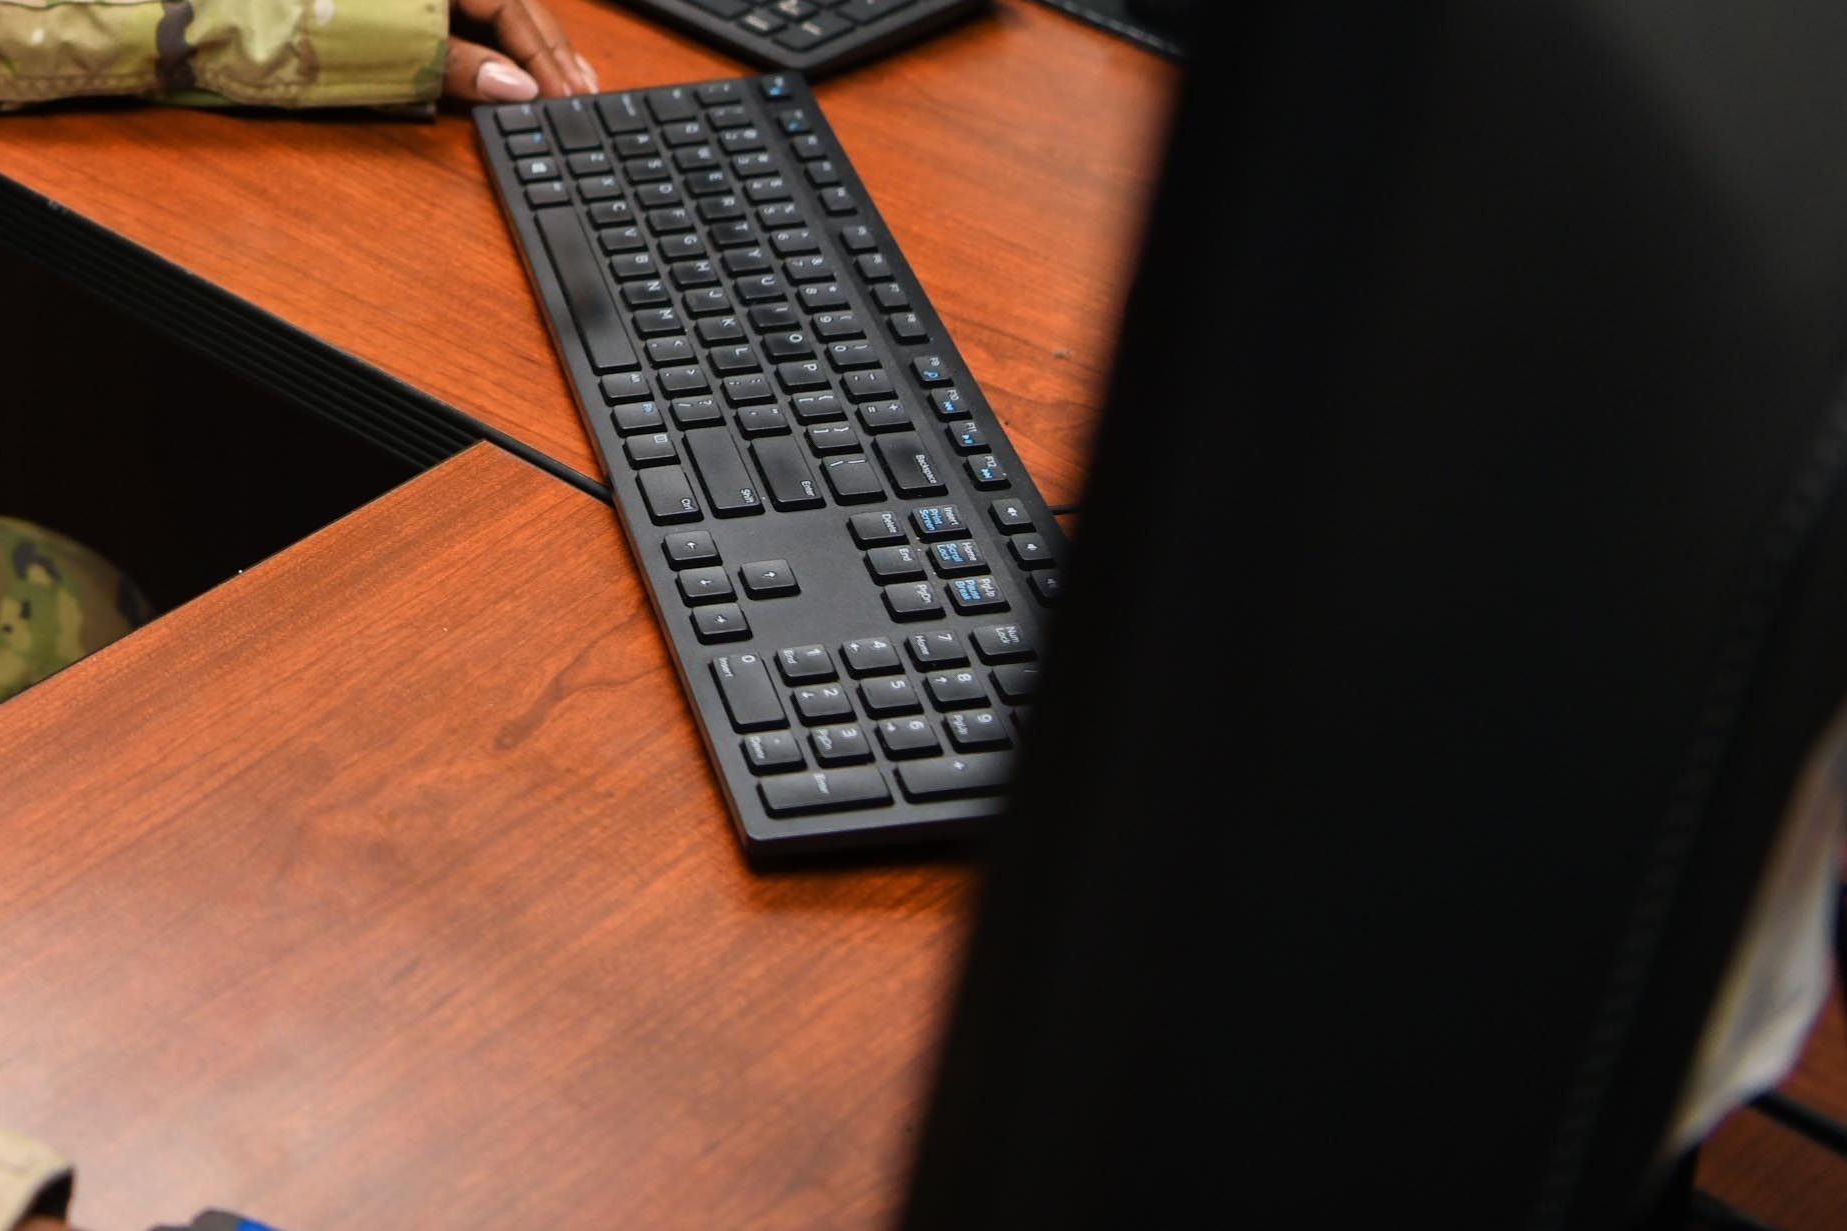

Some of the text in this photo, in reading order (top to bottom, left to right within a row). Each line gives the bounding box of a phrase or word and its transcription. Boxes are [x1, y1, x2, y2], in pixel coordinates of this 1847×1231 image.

[708, 172, 724, 181] E
[612, 201, 627, 211] C
[722, 196, 736, 206] R
[672, 208, 686, 217] F
[624, 227, 637, 237] V
[735, 222, 749, 231] T
[683, 235, 698, 245] G
[777, 231, 790, 241] 6
[748, 248, 762, 258] Y
[634, 254, 649, 264] B
[695, 260, 711, 272] H
[646, 280, 661, 291] N
[760, 275, 775, 286] U
[708, 290, 723, 298] J
[805, 287, 818, 295] 8
[658, 308, 674, 320] M
[819, 315, 832, 323] 9
[721, 317, 736, 327] K
[789, 333, 803, 343] O
[735, 346, 748, 356] L
[834, 345, 847, 353] 0
[929, 356, 941, 367] F9
[803, 363, 818, 372] P
[946, 390, 960, 403] F10
[965, 421, 978, 433] F11
[984, 455, 998, 468] F12
[915, 454, 938, 484] Backspace
[801, 480, 815, 497] Enter
[740, 488, 756, 506] Shift
[680, 498, 694, 512] Ctrl
[919, 508, 935, 531] Screen
[928, 509, 943, 526] Print
[943, 506, 959, 526] Insert
[880, 513, 897, 533] Delete
[898, 547, 913, 562] End
[937, 544, 952, 561] Lock
[945, 543, 964, 562] Scroll
[961, 542, 977, 561] Home
[955, 580, 971, 600] Break
[966, 579, 981, 600] Pause
[981, 578, 996, 597] PgUp
[914, 583, 932, 604] PgDn
[937, 633, 953, 641] 7
[994, 627, 1011, 644] Lock
[1005, 626, 1019, 644] Num
[873, 640, 887, 649] 4
[913, 635, 930, 655] Home
[782, 647, 797, 664] End
[806, 648, 822, 656] 1
[741, 654, 756, 664] 0
[718, 657, 734, 678] Insert
[957, 673, 972, 682] 8
[890, 680, 906, 689] 5
[822, 687, 839, 697] 2
[976, 713, 993, 723] 9
[908, 720, 925, 730] 6
[952, 714, 968, 735] PgUp
[841, 728, 858, 738] 3
[812, 772, 829, 794] Enter
